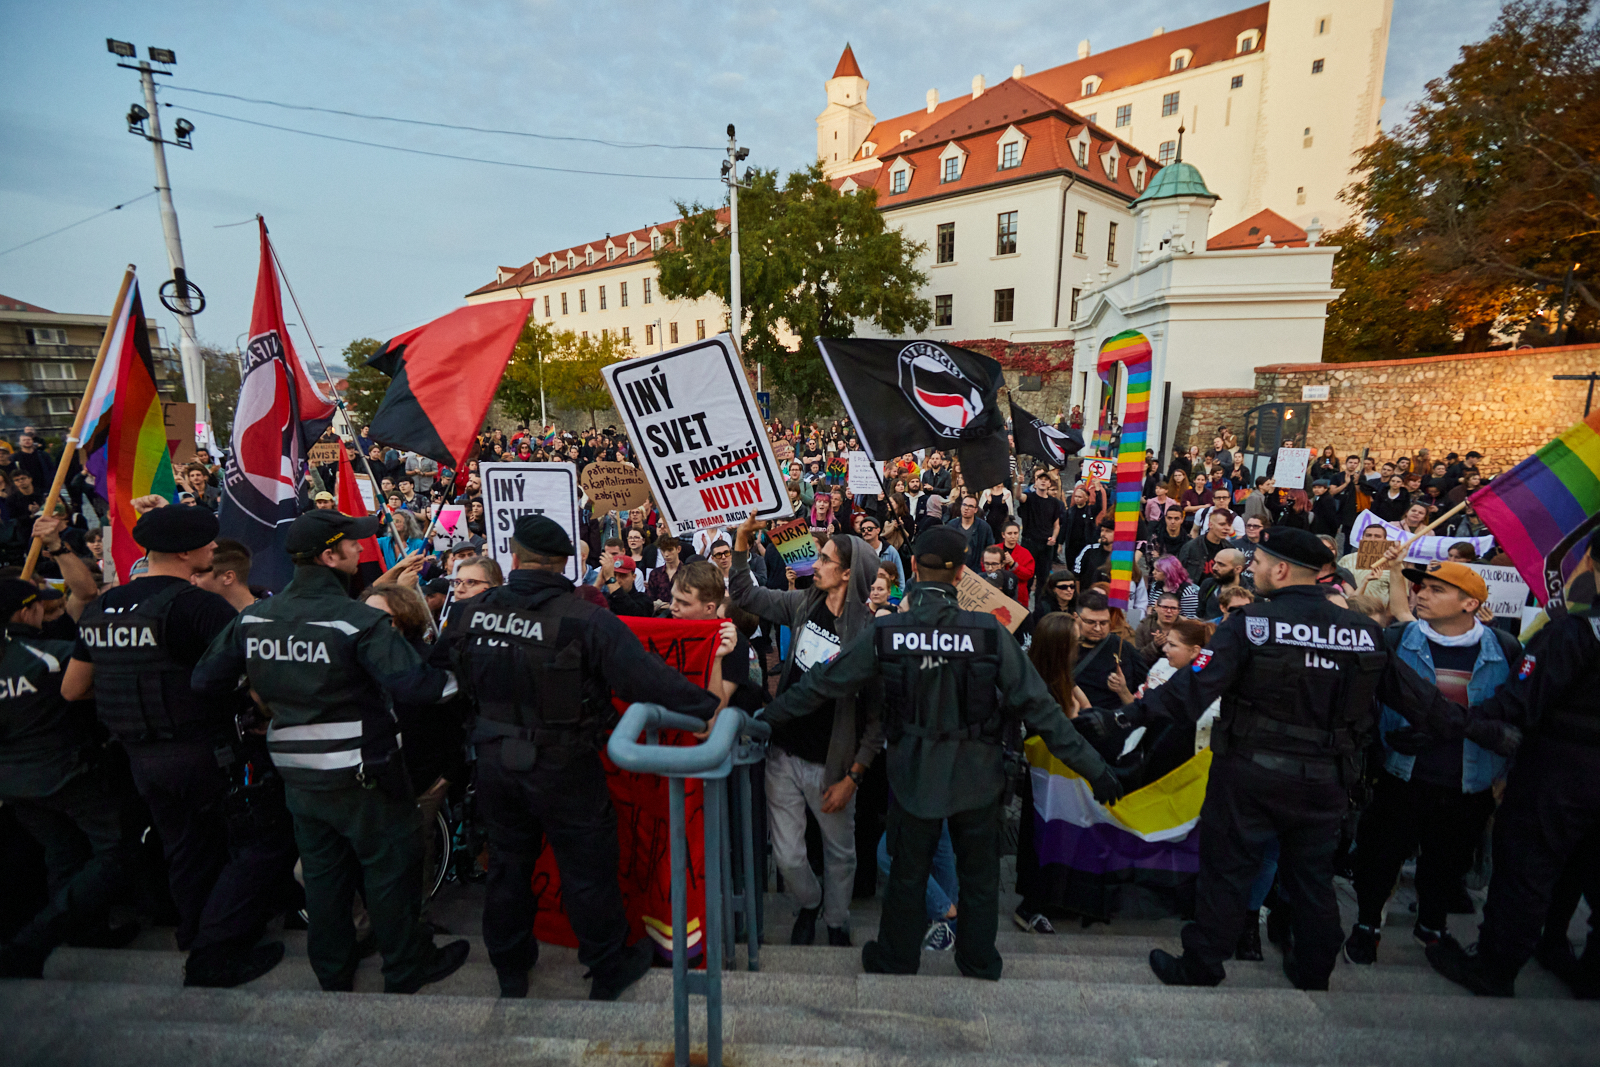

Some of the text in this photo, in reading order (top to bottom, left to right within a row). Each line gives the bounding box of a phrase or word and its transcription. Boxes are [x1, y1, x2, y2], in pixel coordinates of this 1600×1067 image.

[625, 365, 674, 417] INÝ
[646, 412, 714, 457] SVET
[664, 463, 690, 489] JE
[689, 440, 761, 484] MOŽNÝ
[493, 473, 526, 502] INÝ
[589, 475, 644, 490] kapitalizmus
[699, 472, 763, 512] NUTNÝ
[497, 508, 545, 531] SV
[695, 514, 726, 528] PRIAMA
[725, 510, 749, 522] AKCIA
[772, 522, 809, 546] JURAJ
[782, 541, 816, 564] MATÚŠ
[470, 611, 544, 641] POLÍCIA
[1275, 621, 1375, 647] POLÍCIA
[246, 635, 331, 664] POLÍCIA
[893, 629, 975, 652] POLÍCIA
